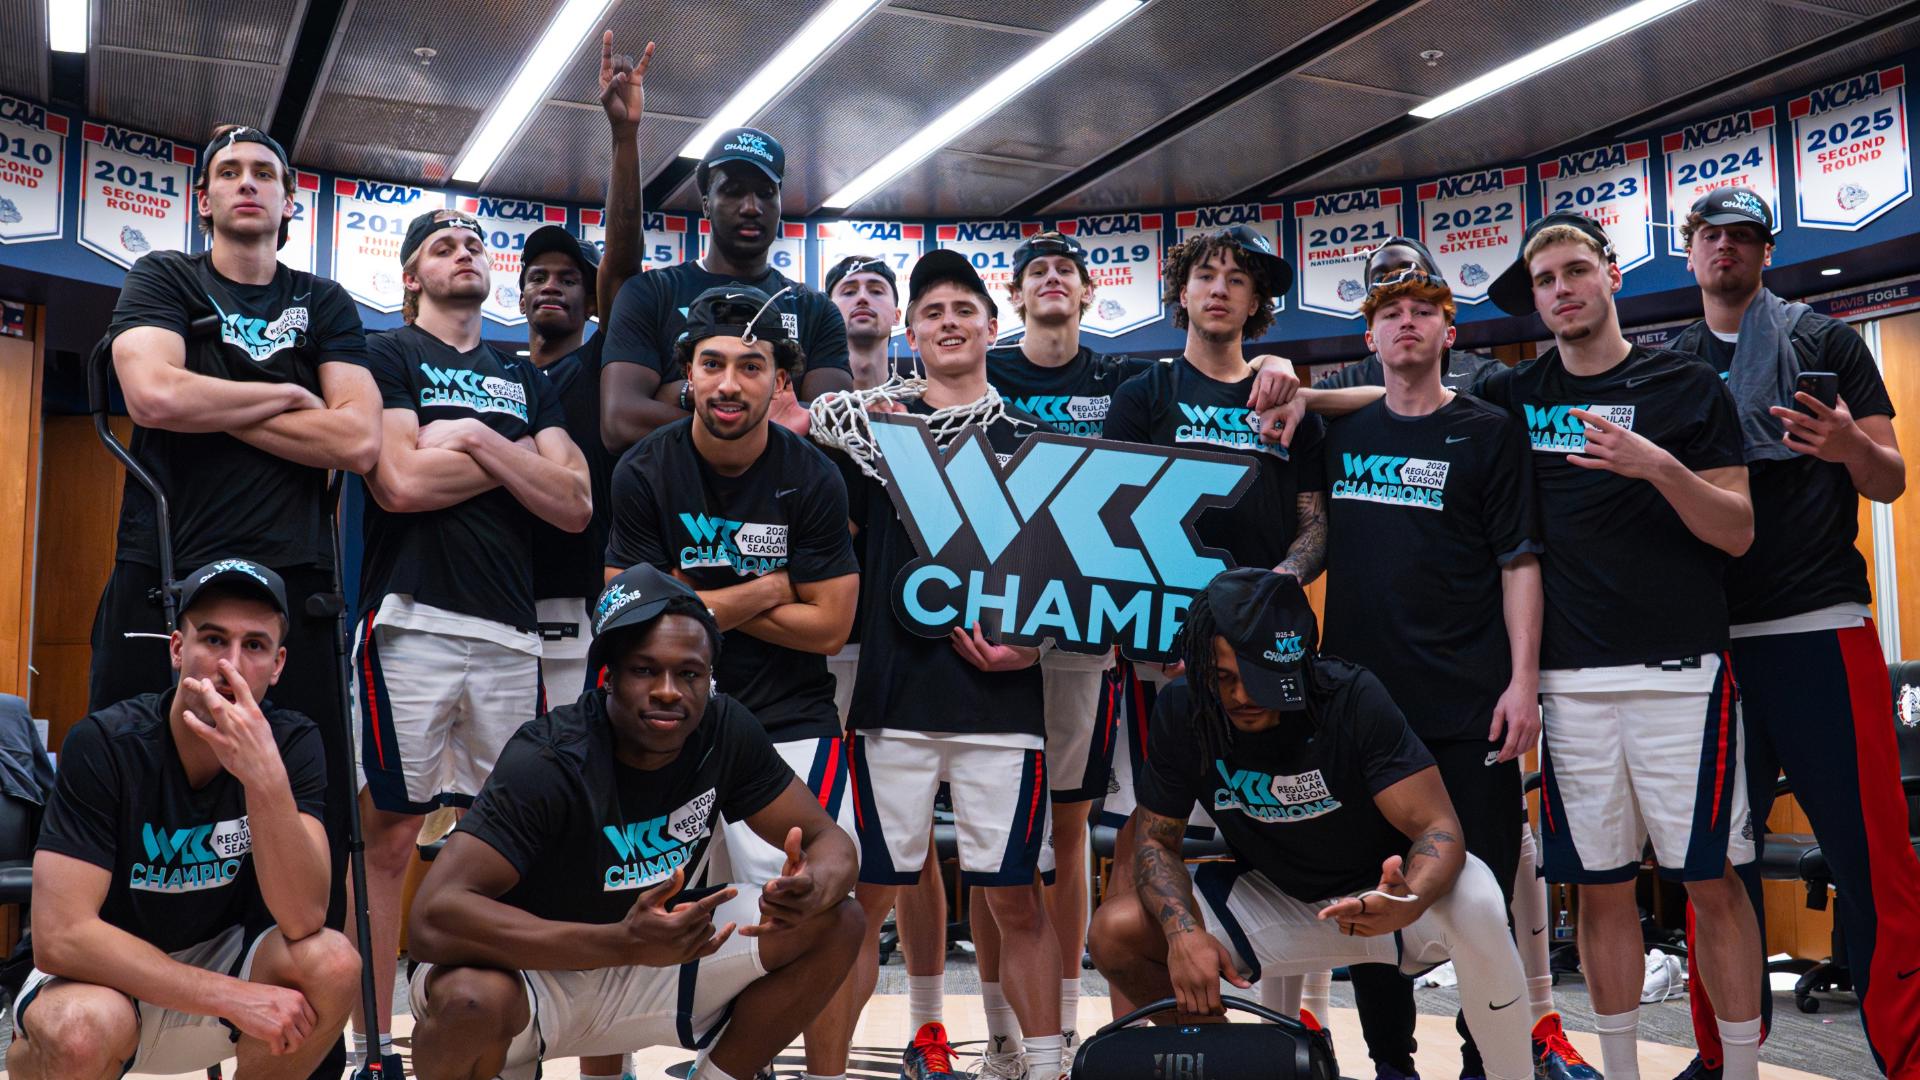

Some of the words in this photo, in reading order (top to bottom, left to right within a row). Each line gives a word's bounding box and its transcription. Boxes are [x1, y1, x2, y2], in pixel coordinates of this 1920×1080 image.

[1809, 74, 1881, 117] NCAA
[0, 96, 46, 131] CAA
[1682, 112, 1751, 151] NCAA
[1807, 107, 1894, 153] 2025
[104, 127, 174, 164] NCAA
[1817, 136, 1886, 164] SECOND
[0, 157, 44, 179] COND
[1558, 144, 1626, 179] NCAA
[1678, 147, 1763, 186] 2024
[1822, 150, 1883, 175] ROUND
[94, 159, 179, 198] 2011
[1437, 172, 1504, 200] NCAA
[1694, 174, 1749, 196] SWEET
[102, 185, 172, 210] SECOND
[355, 180, 421, 205] NCAA
[1314, 189, 1380, 217] NCAA
[1555, 177, 1638, 210] 2023
[106, 199, 166, 219] ROUND
[477, 198, 544, 223] NCAA
[1195, 203, 1260, 229] NCAA
[1432, 202, 1514, 232] 2022
[346, 211, 406, 236] 201
[957, 222, 1021, 242] NCAA
[1076, 213, 1141, 237] NCAA
[1309, 220, 1391, 248] 2021
[1446, 227, 1501, 242] SWEET
[1308, 248, 1346, 260] FINAL
[1440, 236, 1508, 254] SIXTEEN
[1090, 266, 1132, 277] ELITE
[1311, 257, 1351, 267] NATIONAL
[1096, 276, 1133, 287] IGHT
[1867, 286, 1909, 304] FOGLE
[1636, 331, 1668, 345] METZ
[420, 363, 489, 397] WCC
[421, 388, 528, 422] CHAMPIONS
[1178, 402, 1250, 431] WCC
[1343, 453, 1408, 484] WCC
[1405, 467, 1444, 479] REGULAR
[1426, 462, 1447, 470] 2026
[1333, 480, 1444, 507] CHAMPIONS
[1407, 475, 1443, 487] SEASON
[870, 421, 1250, 589] WCC
[747, 543, 786, 554] SEASON
[903, 564, 1190, 653] CHAMP
[1277, 780, 1324, 793] REGULAR
[1295, 772, 1320, 785] 2026
[1286, 789, 1327, 802] SEASON
[217, 832, 250, 845] REGUL
[225, 840, 250, 854] SEAS
[603, 815, 681, 862] WCC
[131, 859, 241, 889] CHAMPIO
